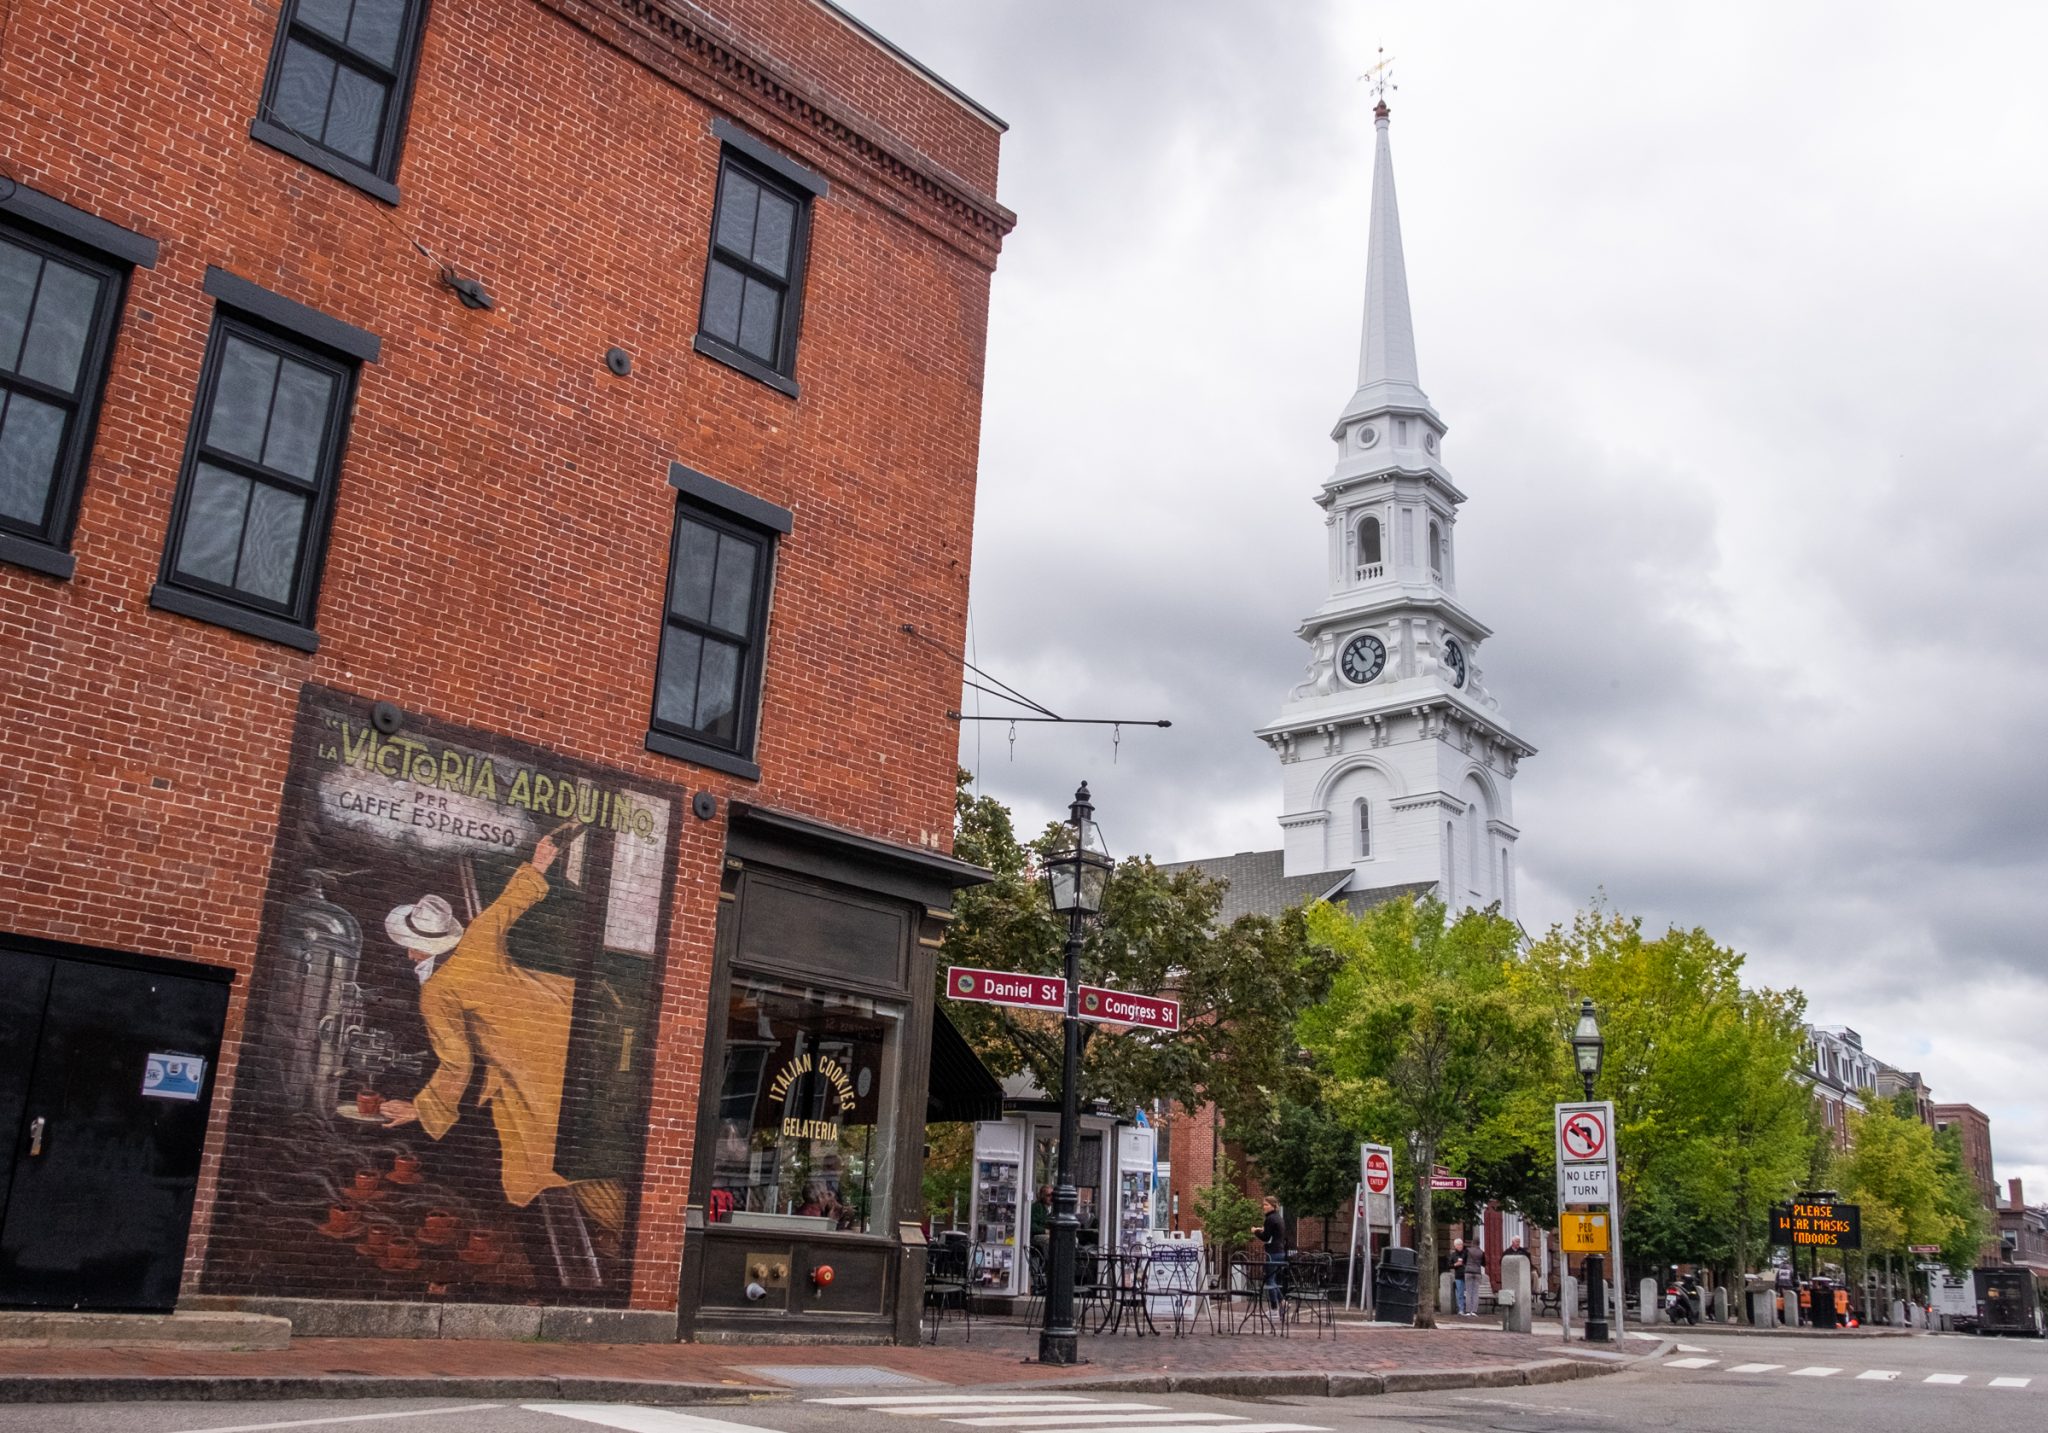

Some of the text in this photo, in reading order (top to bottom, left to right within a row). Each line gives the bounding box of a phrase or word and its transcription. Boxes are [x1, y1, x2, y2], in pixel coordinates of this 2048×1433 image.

[318, 743, 338, 761] LA
[414, 791, 448, 810] PER
[411, 807, 515, 846] ESPRESSO
[984, 979, 1057, 1001] Daniel St
[1105, 998, 1173, 1023] Congress St
[769, 1053, 856, 1110] ITALIAN COOKIES
[783, 1117, 838, 1141] GELATERIA
[1566, 1170, 1607, 1181] NO LEFT
[1572, 1185, 1598, 1196] TURN
[1794, 1204, 1833, 1217] PLEASE
[1578, 1222, 1593, 1233] PED
[1814, 1219, 1850, 1232] MASKS
[1577, 1233, 1594, 1244] XING
